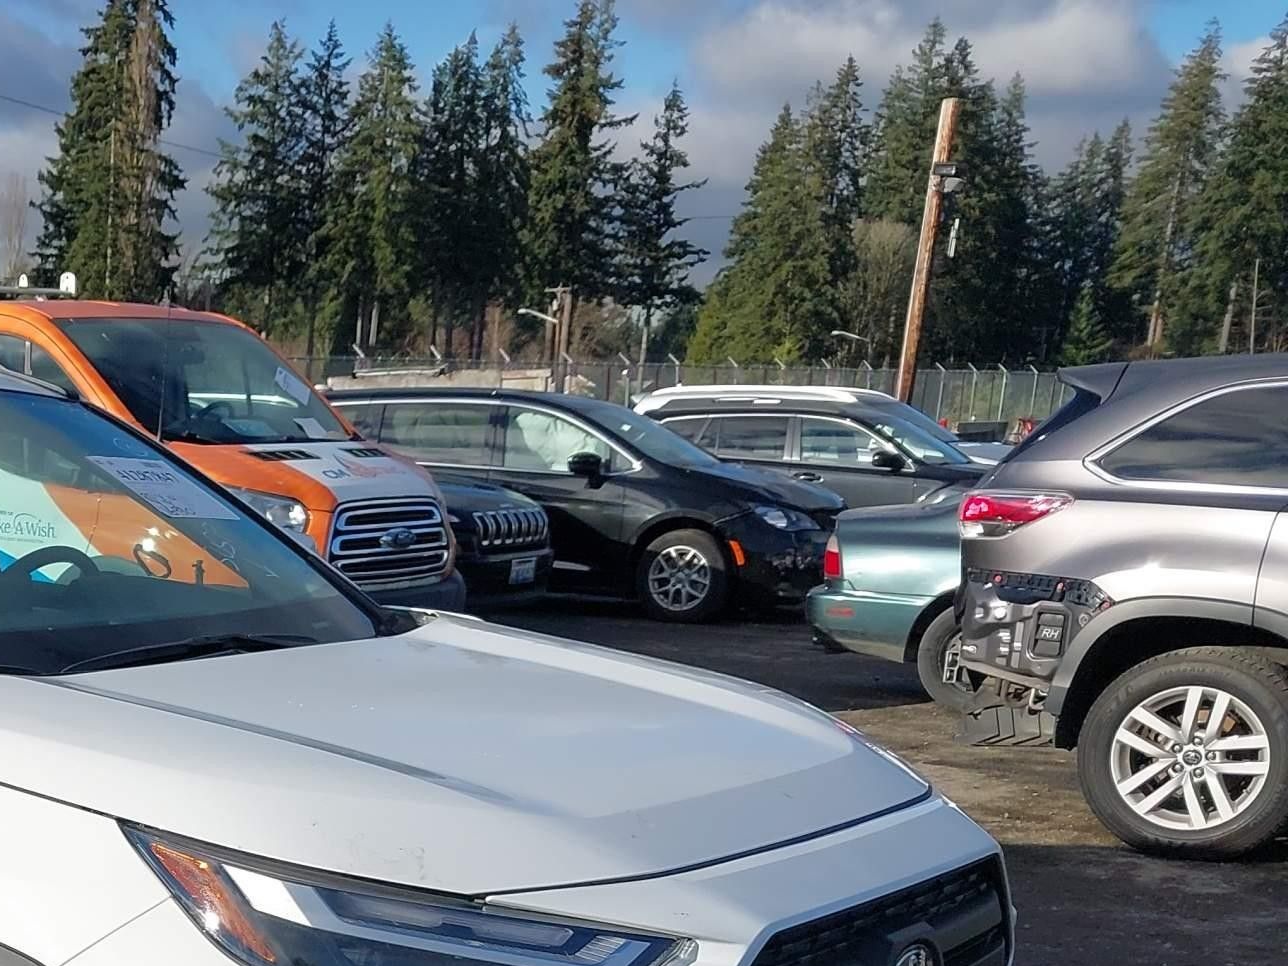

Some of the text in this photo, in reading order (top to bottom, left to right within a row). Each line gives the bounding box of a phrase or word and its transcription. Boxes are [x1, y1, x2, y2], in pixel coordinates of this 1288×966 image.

[15, 521, 24, 535] A
[25, 519, 56, 538] Wish
[1041, 628, 1060, 639] RH
